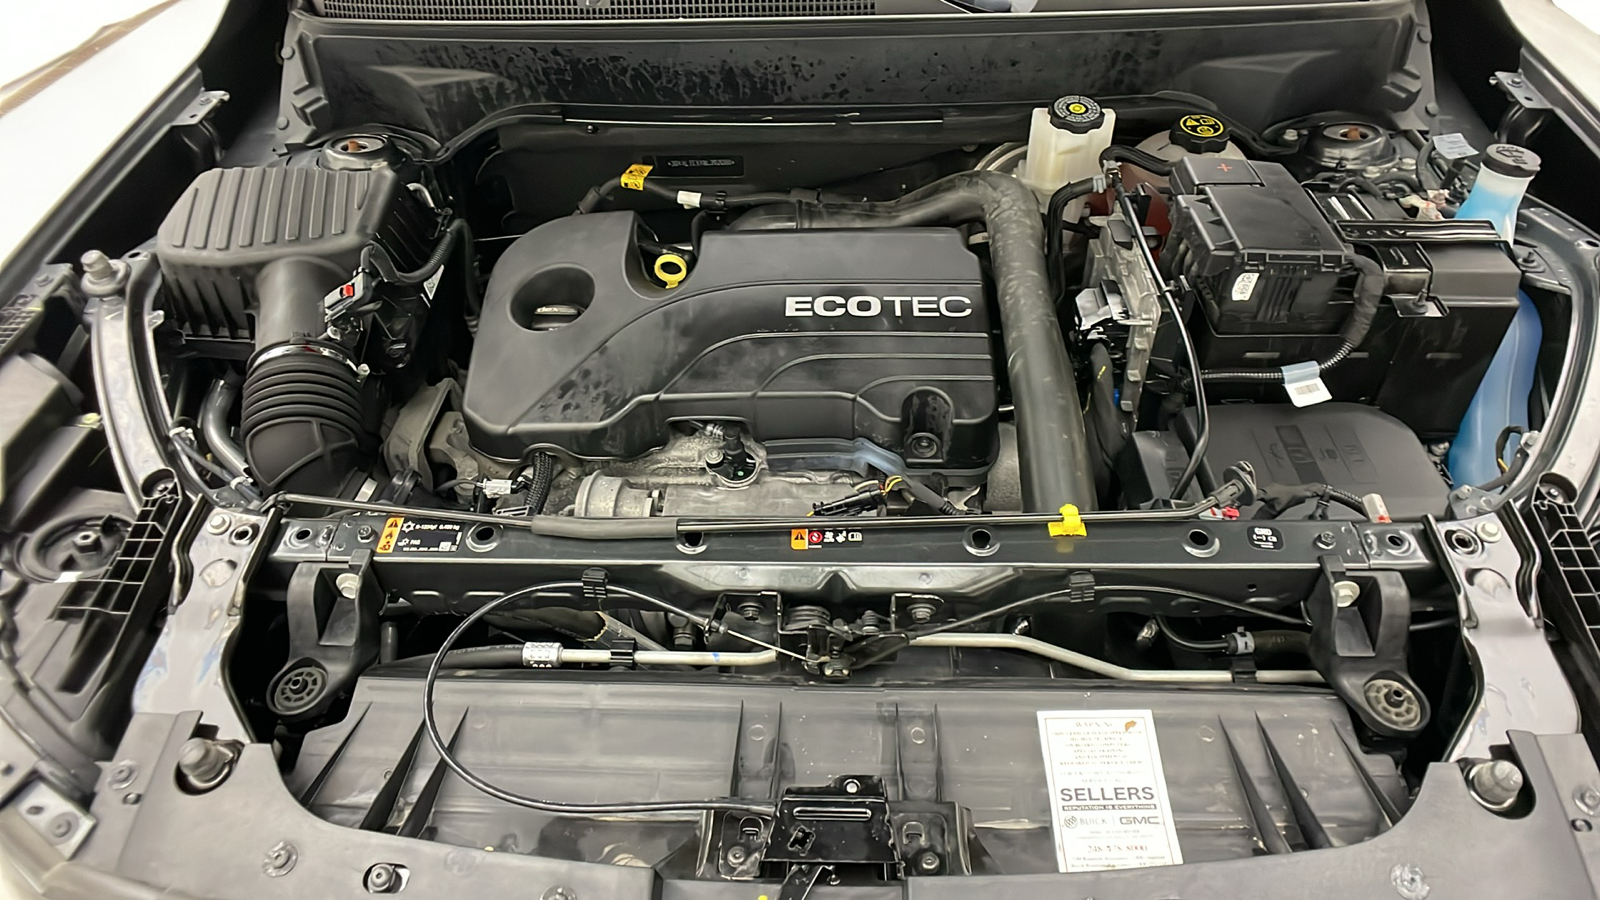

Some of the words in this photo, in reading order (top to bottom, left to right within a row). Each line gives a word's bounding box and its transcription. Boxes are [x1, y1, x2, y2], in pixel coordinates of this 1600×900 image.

[785, 296, 973, 317] ECOTEC
[1060, 787, 1155, 802] SELLERS
[1079, 817, 1108, 826] BUICK
[1119, 816, 1160, 825] GMC
